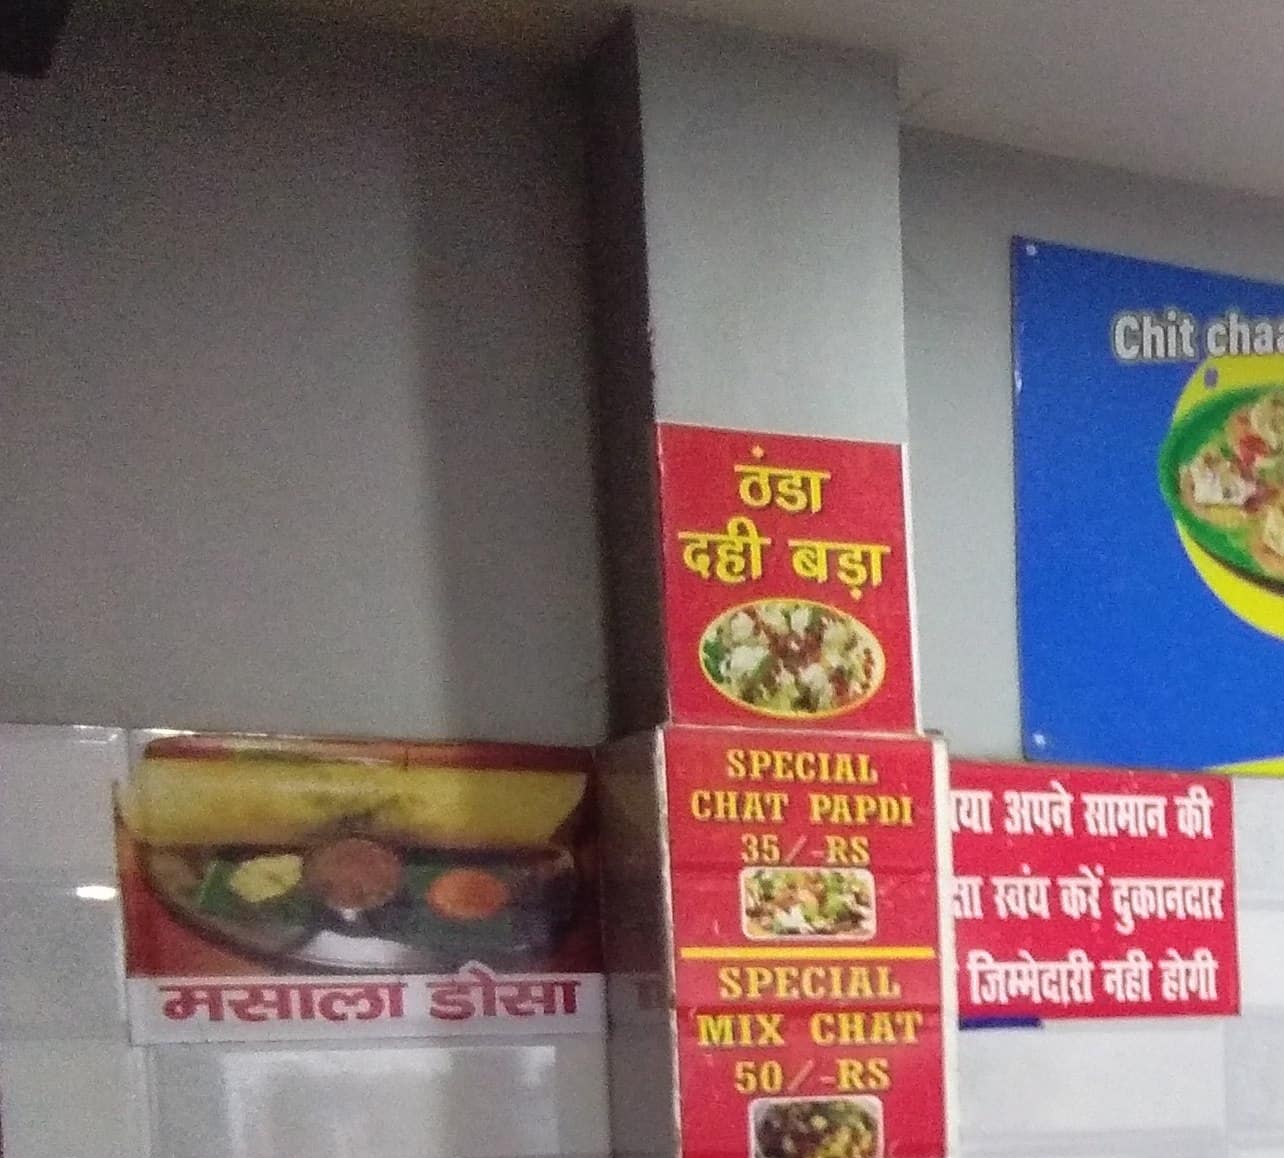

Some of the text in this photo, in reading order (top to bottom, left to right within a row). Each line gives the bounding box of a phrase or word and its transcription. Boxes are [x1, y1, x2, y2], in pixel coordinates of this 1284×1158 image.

[1112, 306, 1198, 362] Chit
[734, 445, 831, 514] ठंडा
[678, 515, 891, 600] दही बड़ा
[726, 749, 878, 784] SPECIAL
[690, 789, 914, 825] CHAT PAPDI
[1004, 780, 1073, 837] अपने
[1081, 793, 1168, 838] सामान
[1174, 784, 1214, 839] की
[1057, 863, 1104, 919] करें
[1110, 877, 1224, 936] दुकानदार
[160, 966, 583, 1022] मसाला डोसा
[718, 966, 901, 1000] SPECIAL
[967, 949, 1218, 1006] जिम्मेदारी नही होगी
[697, 1011, 923, 1047] MIX CHAT
